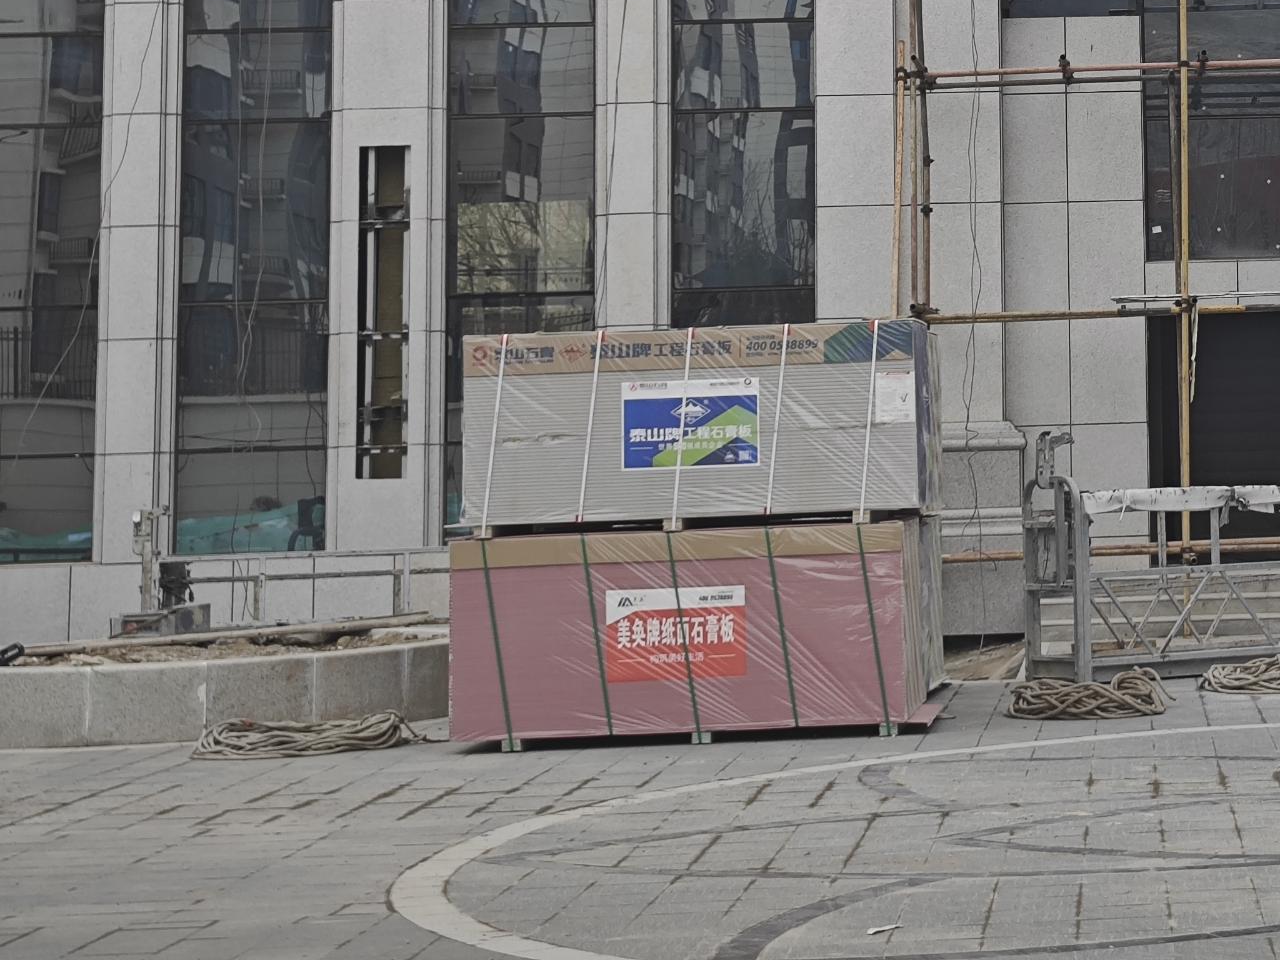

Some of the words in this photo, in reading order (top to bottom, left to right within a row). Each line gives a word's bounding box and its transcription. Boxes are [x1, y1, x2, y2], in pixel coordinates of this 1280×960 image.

[617, 614, 735, 649] 美奂牌纸面石膏板
